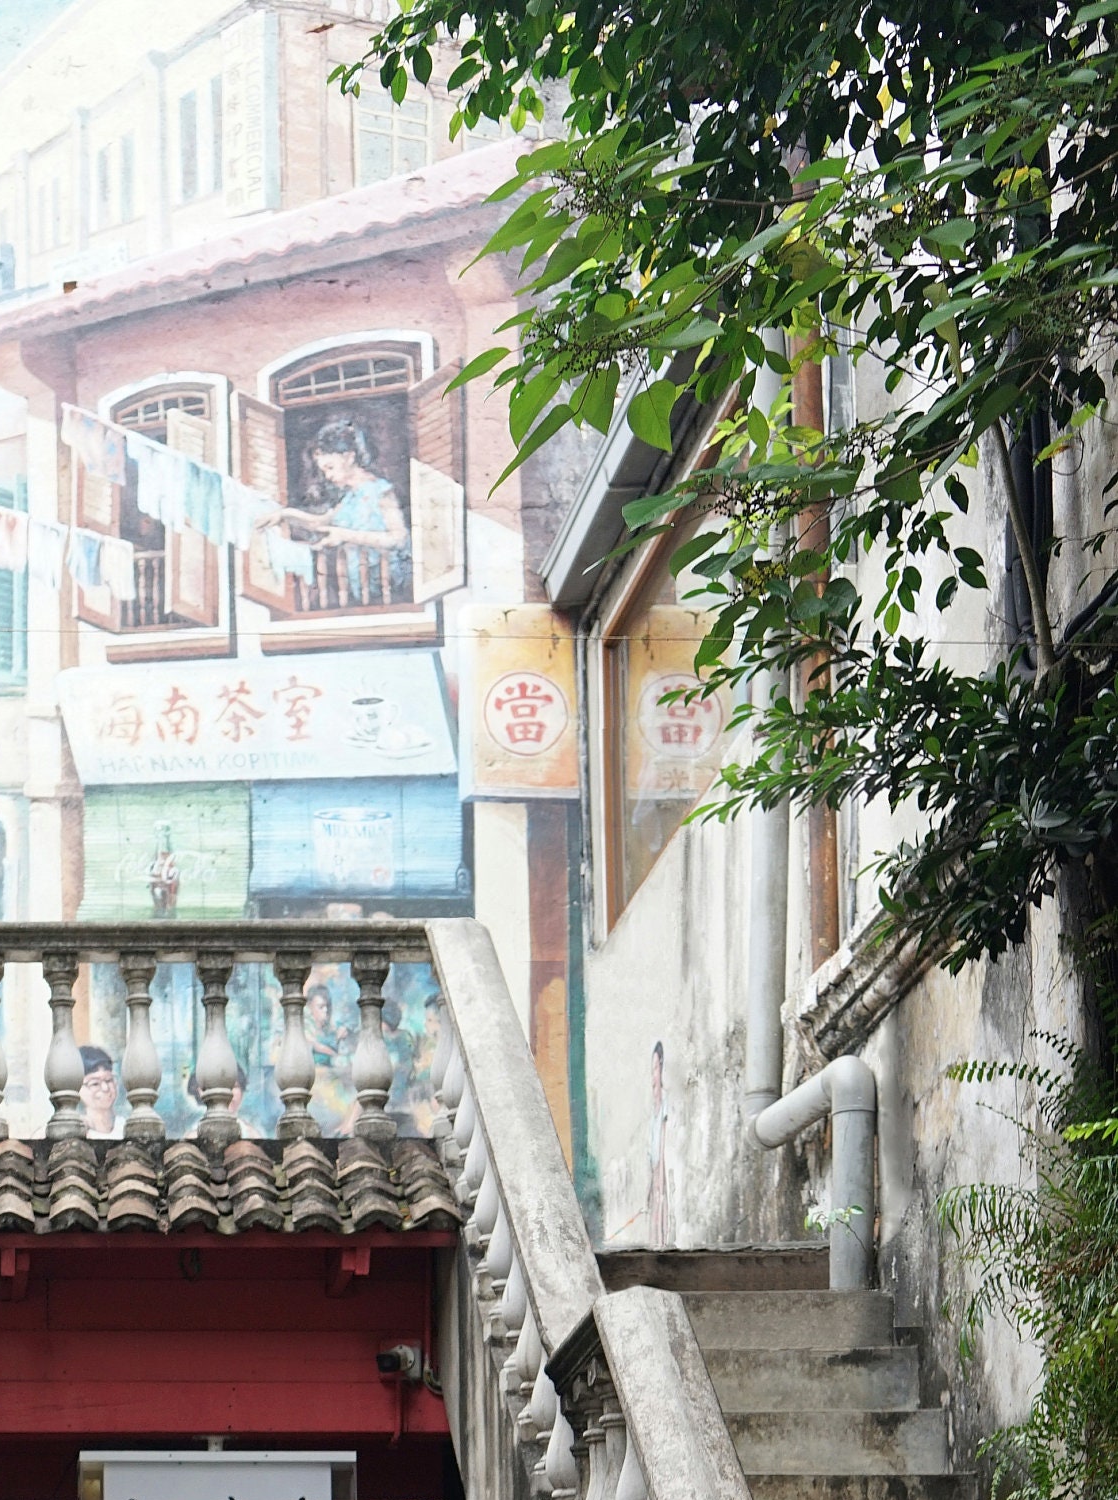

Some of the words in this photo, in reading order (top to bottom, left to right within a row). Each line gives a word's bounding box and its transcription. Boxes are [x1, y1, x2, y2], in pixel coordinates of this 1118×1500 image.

[96, 676, 323, 745] 海南茶室
[494, 681, 554, 745] 當
